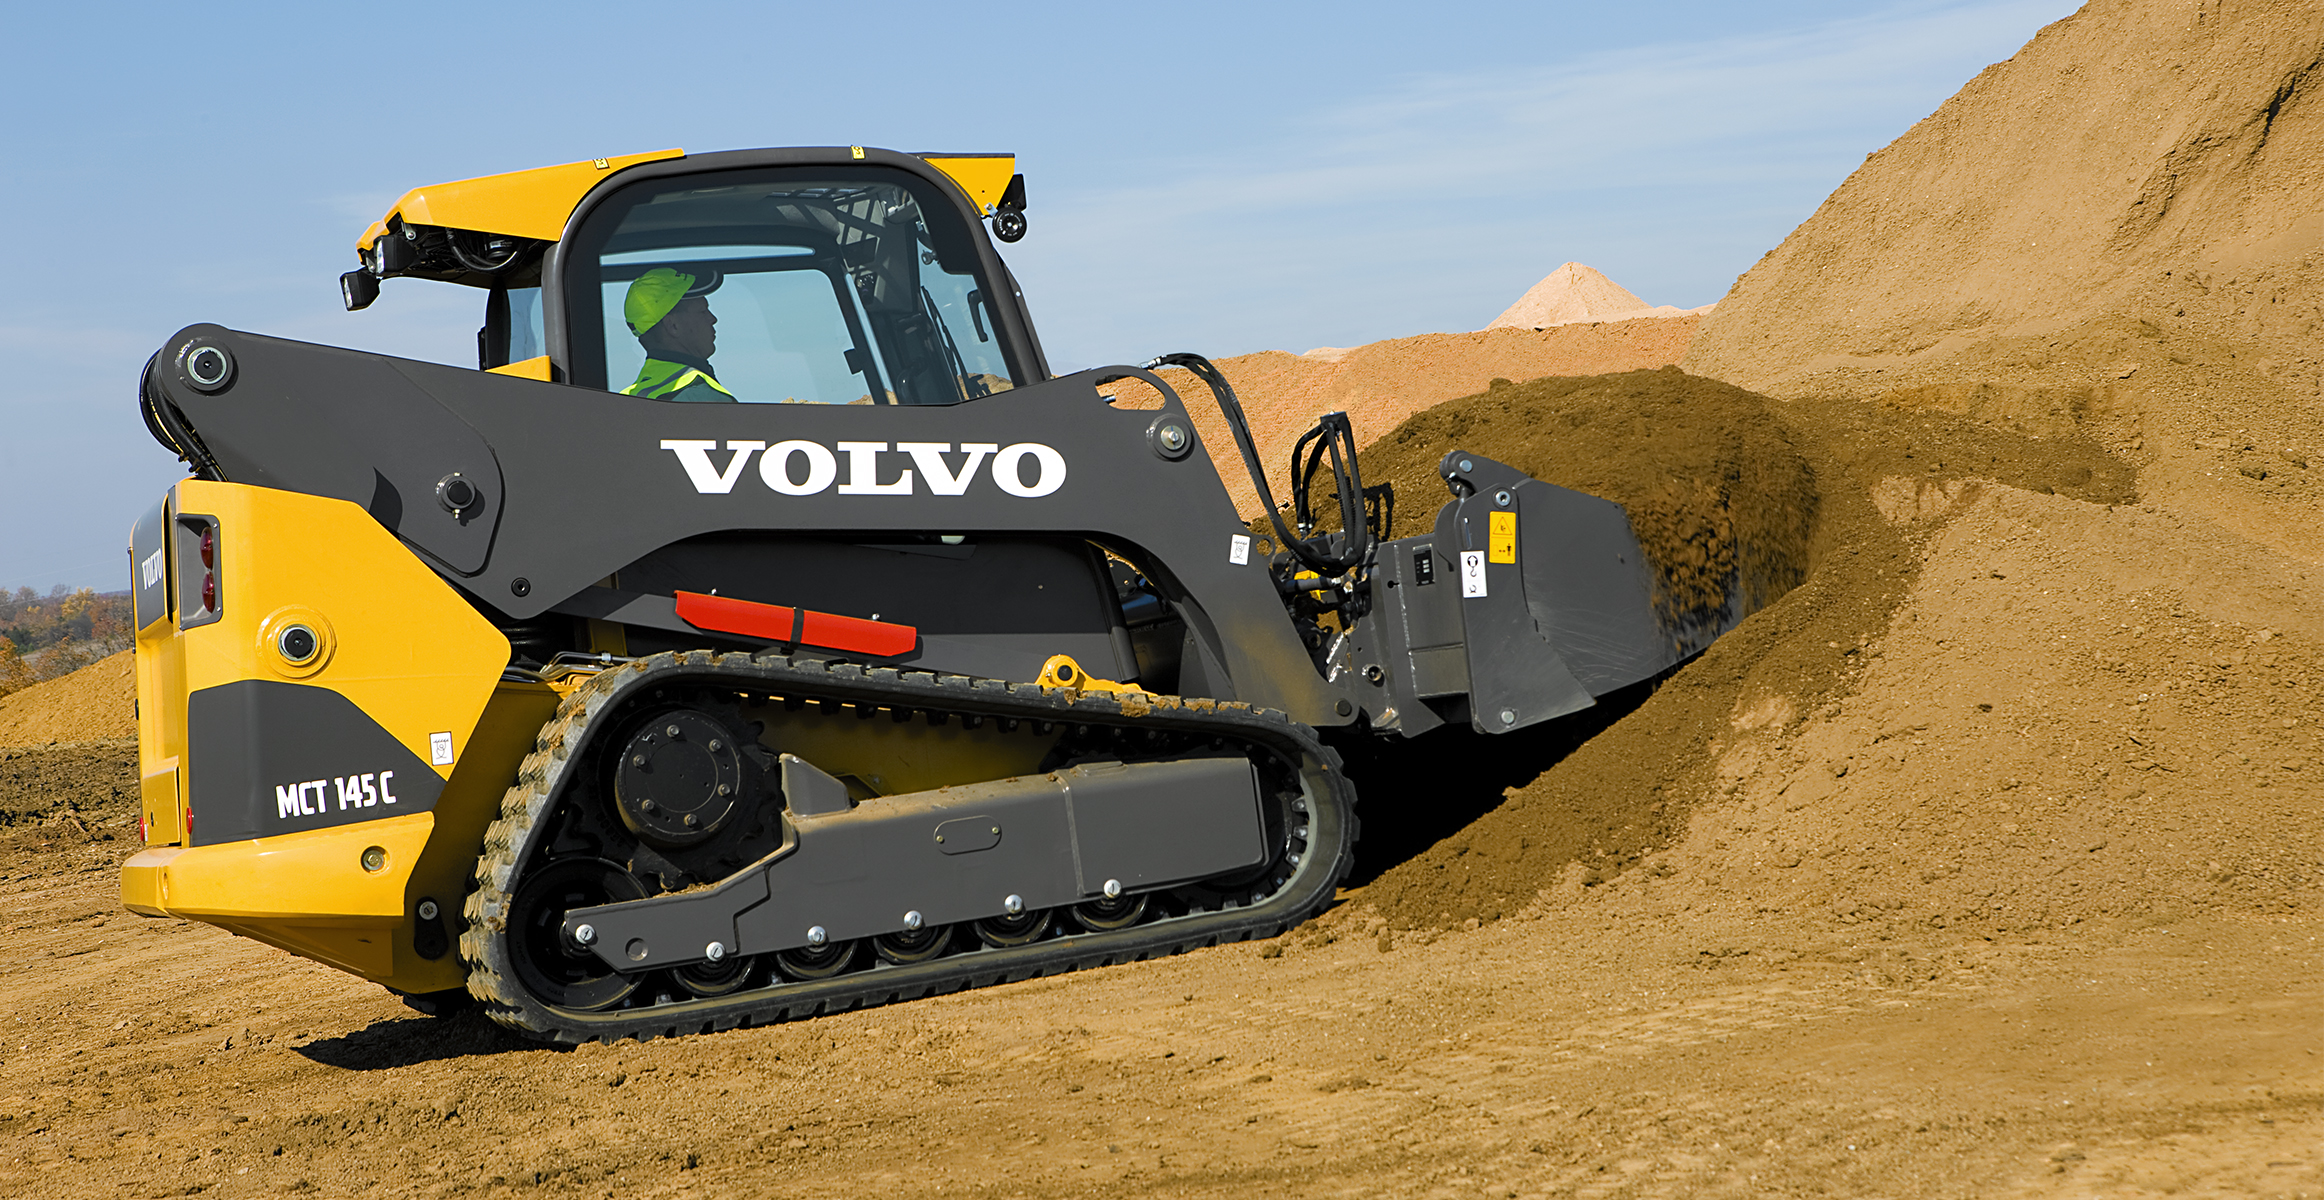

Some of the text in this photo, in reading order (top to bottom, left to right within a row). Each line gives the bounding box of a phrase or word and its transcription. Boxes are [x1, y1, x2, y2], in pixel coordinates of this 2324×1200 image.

[660, 439, 1067, 498] VOLVO
[142, 548, 162, 590] VOLVO
[275, 770, 397, 819] MCT 145 C
